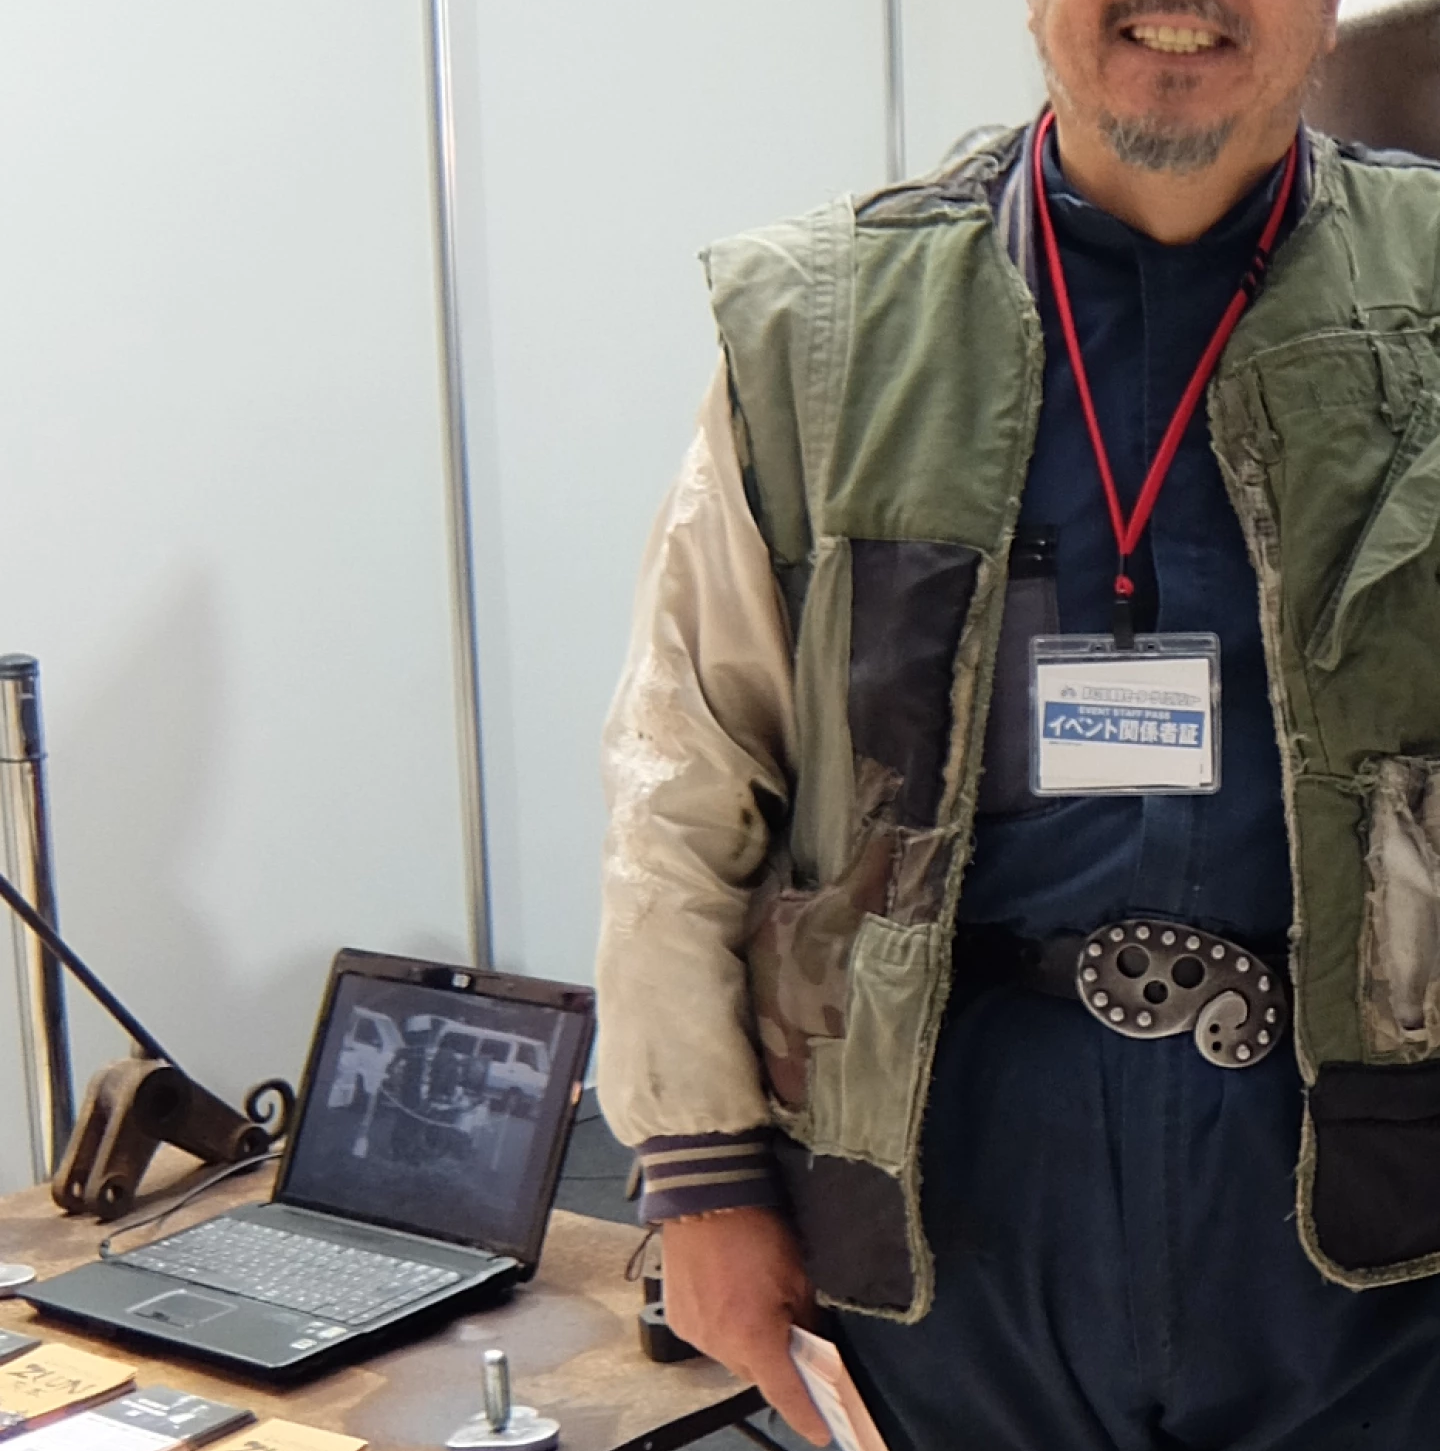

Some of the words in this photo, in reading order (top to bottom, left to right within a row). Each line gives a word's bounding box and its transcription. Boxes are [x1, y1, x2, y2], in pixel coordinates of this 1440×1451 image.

[1048, 715, 1199, 746] イベント関係者証
